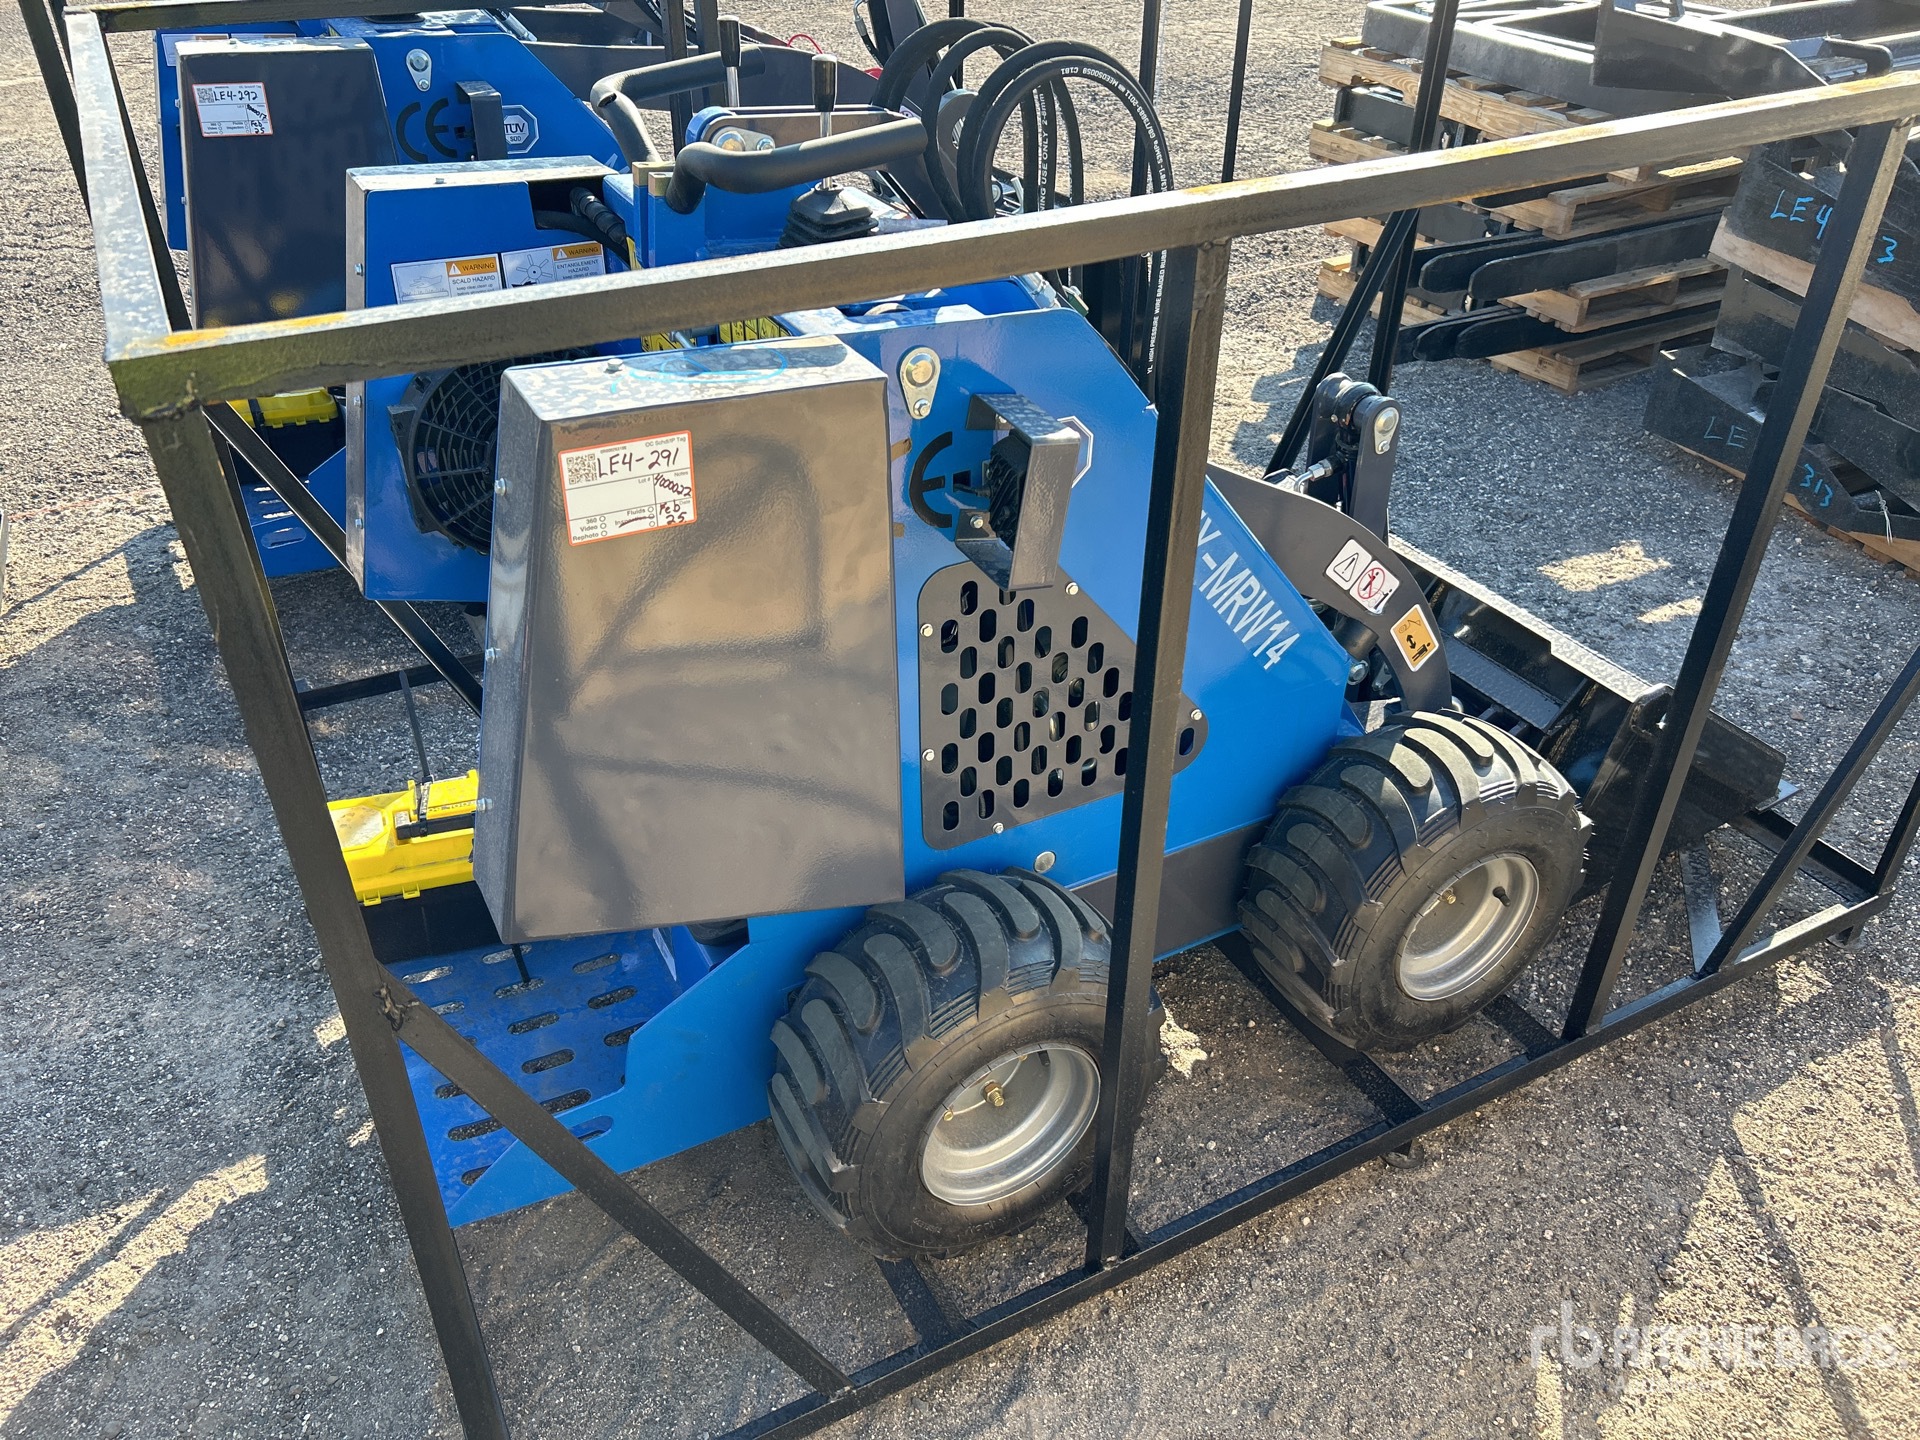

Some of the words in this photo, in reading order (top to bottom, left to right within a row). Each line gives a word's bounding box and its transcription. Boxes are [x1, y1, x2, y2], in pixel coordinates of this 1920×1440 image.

[213, 89, 258, 101] LE4-292
[1041, 131, 1049, 161] ONLY
[1040, 163, 1049, 185] USE
[568, 246, 599, 256] WARNING
[462, 262, 495, 272] WARNING
[451, 277, 472, 286] SCALD
[472, 273, 496, 283] HAZARD
[1156, 269, 1165, 297] BRAIDED
[1154, 297, 1162, 315] WIRE
[1150, 315, 1159, 347] PRESSURE
[597, 448, 679, 478] LE4-291
[1799, 462, 1834, 508] 313
[626, 507, 646, 517] Fluids
[659, 499, 680, 515] Feb
[572, 531, 600, 542] Rephoto
[580, 524, 599, 533] Video
[1197, 510, 1300, 670] Y-MRW14
